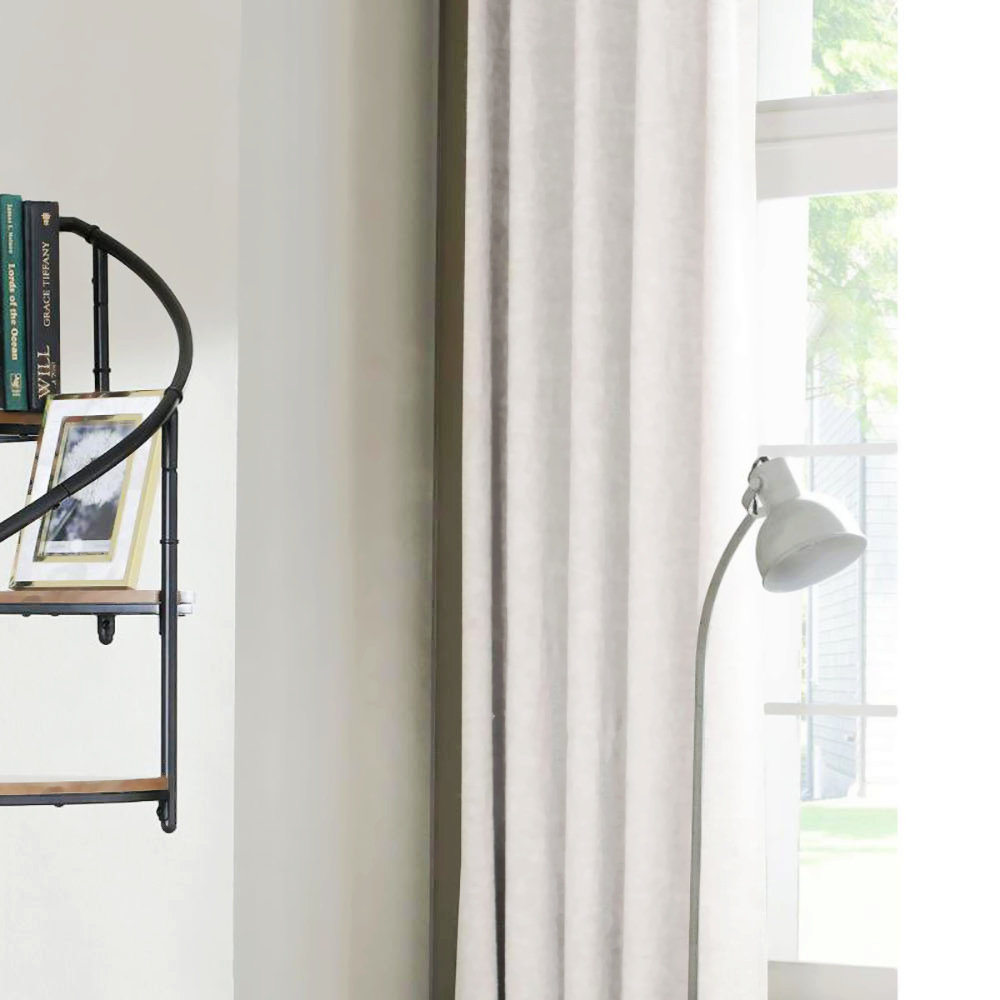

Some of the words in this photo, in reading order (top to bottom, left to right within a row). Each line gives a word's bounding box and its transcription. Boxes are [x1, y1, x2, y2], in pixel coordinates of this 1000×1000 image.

[8, 263, 17, 294] Lords
[41, 241, 51, 288] TIFFANY
[9, 295, 18, 307] of
[9, 308, 18, 326] the
[42, 289, 51, 327] GRACE
[10, 328, 19, 361] Ocean
[37, 345, 51, 399] WILL
